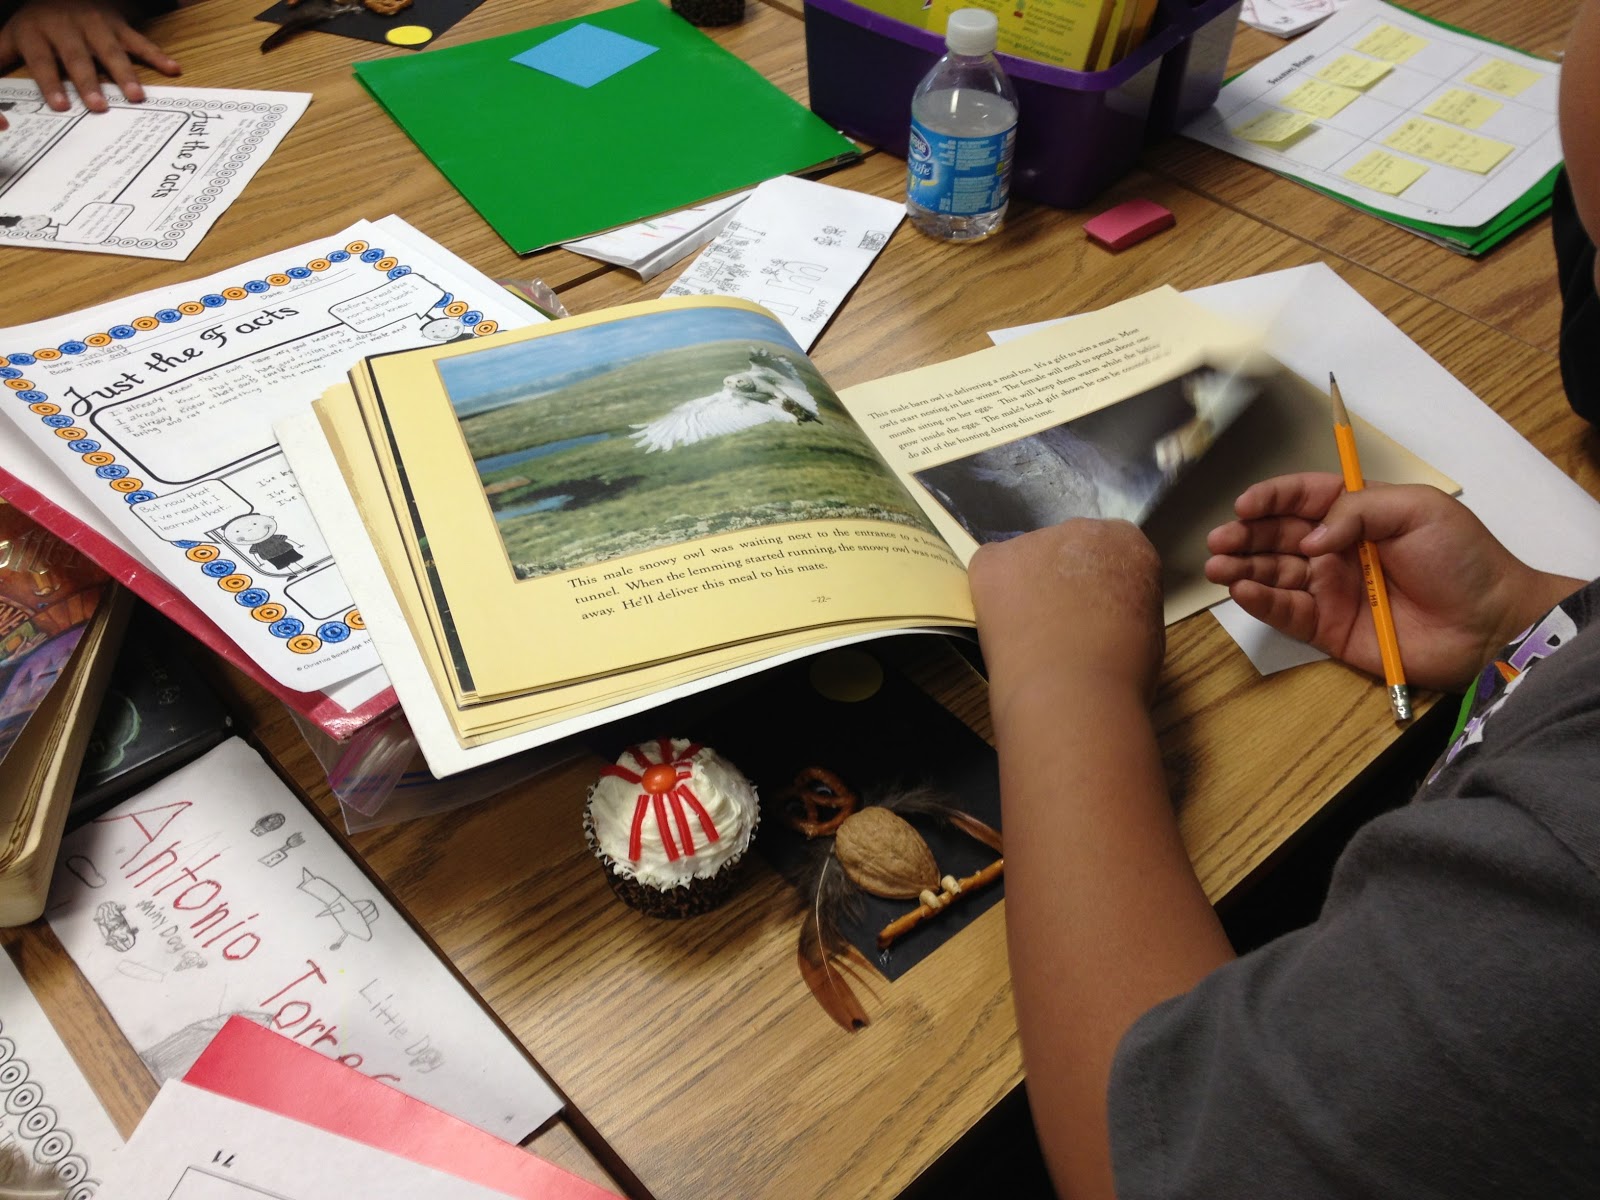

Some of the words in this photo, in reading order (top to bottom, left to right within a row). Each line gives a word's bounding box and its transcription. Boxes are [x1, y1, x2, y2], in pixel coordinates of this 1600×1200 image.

[177, 140, 210, 160] the
[189, 110, 223, 137] Just
[151, 162, 198, 199] Facts
[914, 162, 932, 176] Life
[336, 301, 367, 313] Before
[373, 288, 392, 299] read
[391, 281, 408, 291] this
[355, 312, 385, 325] already
[43, 360, 74, 369] Name:
[49, 367, 73, 375] Book
[63, 373, 145, 417] Just
[144, 347, 204, 373] the
[200, 305, 300, 348] Facts
[125, 396, 164, 413] already
[198, 372, 219, 382] that
[251, 355, 271, 365] have
[274, 349, 291, 360] very
[130, 407, 167, 422] already
[208, 382, 229, 393] that
[233, 374, 252, 384] owls
[257, 363, 275, 375] have
[338, 336, 352, 345] the
[137, 415, 172, 430] already
[212, 387, 235, 399] that
[238, 378, 259, 389] owls
[290, 348, 343, 370] communicate
[391, 324, 408, 335] and
[219, 386, 263, 406] something
[281, 371, 297, 380] the
[867, 411, 889, 421] This
[890, 404, 910, 414] male
[910, 399, 929, 409] barn
[930, 393, 945, 403] owl
[954, 379, 993, 396] delivering
[999, 371, 1018, 382] meal
[1018, 366, 1033, 375] too.
[1034, 359, 1047, 369] It's
[1054, 351, 1068, 364] gift
[1068, 350, 1077, 358] to
[1077, 345, 1092, 355] win
[1098, 337, 1119, 347] mate.
[1118, 328, 1140, 339] Most
[879, 420, 899, 430] owls
[900, 413, 918, 424] start
[920, 405, 950, 418] nesting
[950, 401, 959, 409] in
[959, 397, 975, 406] late
[976, 390, 1002, 401] winter.
[1002, 381, 1020, 392] The
[1020, 373, 1047, 387] female
[1047, 367, 1063, 379] will
[1063, 361, 1082, 373] need
[1082, 358, 1091, 366] to
[1091, 349, 1114, 363] spend
[1115, 341, 1136, 353] about
[1136, 335, 1150, 345] one
[888, 427, 916, 440] month
[918, 418, 945, 431] sitting
[945, 415, 957, 423] on
[957, 409, 972, 420] her
[974, 404, 994, 415] eggs.
[997, 395, 1018, 406] This
[1019, 387, 1036, 399] will
[1036, 381, 1055, 394] keep
[1056, 374, 1076, 386] them
[1077, 366, 1100, 378] warm
[1101, 357, 1123, 370] while
[1123, 352, 1137, 362] the
[898, 440, 918, 451] grow
[920, 430, 945, 443] inside
[946, 426, 960, 436] the
[961, 421, 981, 432] eggs.
[981, 414, 1000, 424] The
[1001, 406, 1025, 418] male's
[1025, 398, 1044, 411] food
[1045, 391, 1060, 405] gift
[1060, 385, 1085, 398] shows
[1085, 379, 1095, 389] he
[1096, 374, 1110, 384] can
[1109, 370, 1121, 379] be
[908, 450, 919, 460] do
[920, 446, 932, 456] all
[933, 442, 943, 452] of
[943, 437, 957, 448] the
[957, 429, 991, 445] hunting
[991, 421, 1019, 435] during
[1018, 413, 1034, 425] this
[1034, 407, 1055, 419] time.
[138, 503, 161, 514] But
[163, 496, 186, 509] now
[186, 486, 211, 500] that
[149, 512, 173, 523] I've
[174, 503, 199, 517] read
[158, 515, 202, 532] learned
[567, 576, 598, 589] This
[603, 566, 634, 581] male
[639, 557, 677, 572] snowy
[683, 548, 706, 562] owl
[711, 543, 734, 554] was
[739, 534, 783, 549] waiting
[788, 531, 812, 541] next
[817, 529, 829, 538] to
[833, 528, 850, 537] the
[854, 528, 896, 539] entrance
[899, 531, 910, 541] to
[575, 587, 620, 604] tunnel.
[625, 577, 664, 591] When
[666, 571, 686, 582] the
[689, 560, 743, 577] lemming
[744, 550, 785, 565] started
[787, 545, 837, 557] running,
[839, 542, 855, 552] the
[857, 544, 890, 554] snowy
[892, 545, 910, 554] owl
[911, 549, 929, 558] was
[581, 606, 615, 621] away.
[622, 594, 654, 611] He'll
[657, 586, 699, 602] deliver
[702, 577, 725, 591] this
[728, 571, 758, 586] meal
[761, 568, 773, 579] to
[776, 565, 794, 576] his
[797, 562, 828, 573] mate.
[92, 801, 261, 961] Antonio
[260, 959, 401, 1082] Torre
